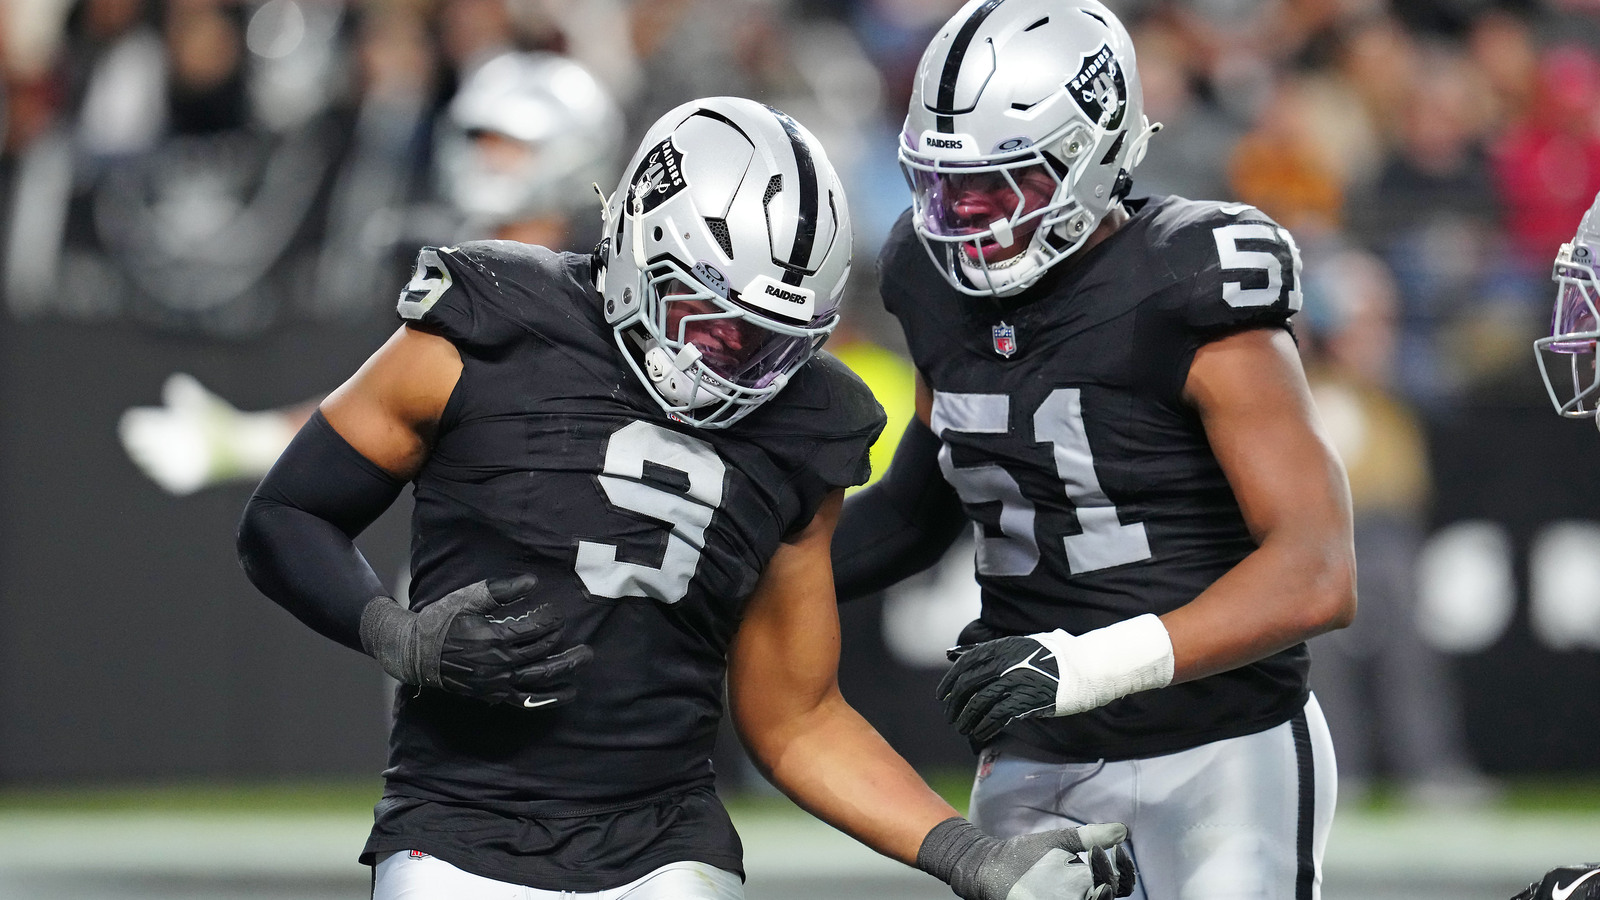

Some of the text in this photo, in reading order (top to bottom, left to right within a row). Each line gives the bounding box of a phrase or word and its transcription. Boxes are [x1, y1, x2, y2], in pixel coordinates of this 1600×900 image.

[1071, 48, 1110, 91] RAIDERS
[662, 142, 683, 187] RAIDERS
[926, 138, 962, 149] RAIDERS
[397, 248, 453, 320] 9
[695, 265, 726, 291] OAKLEY
[1212, 224, 1304, 311] 51
[765, 285, 807, 305] RAIDERS
[930, 388, 1152, 577] 51
[574, 419, 727, 605] 9
